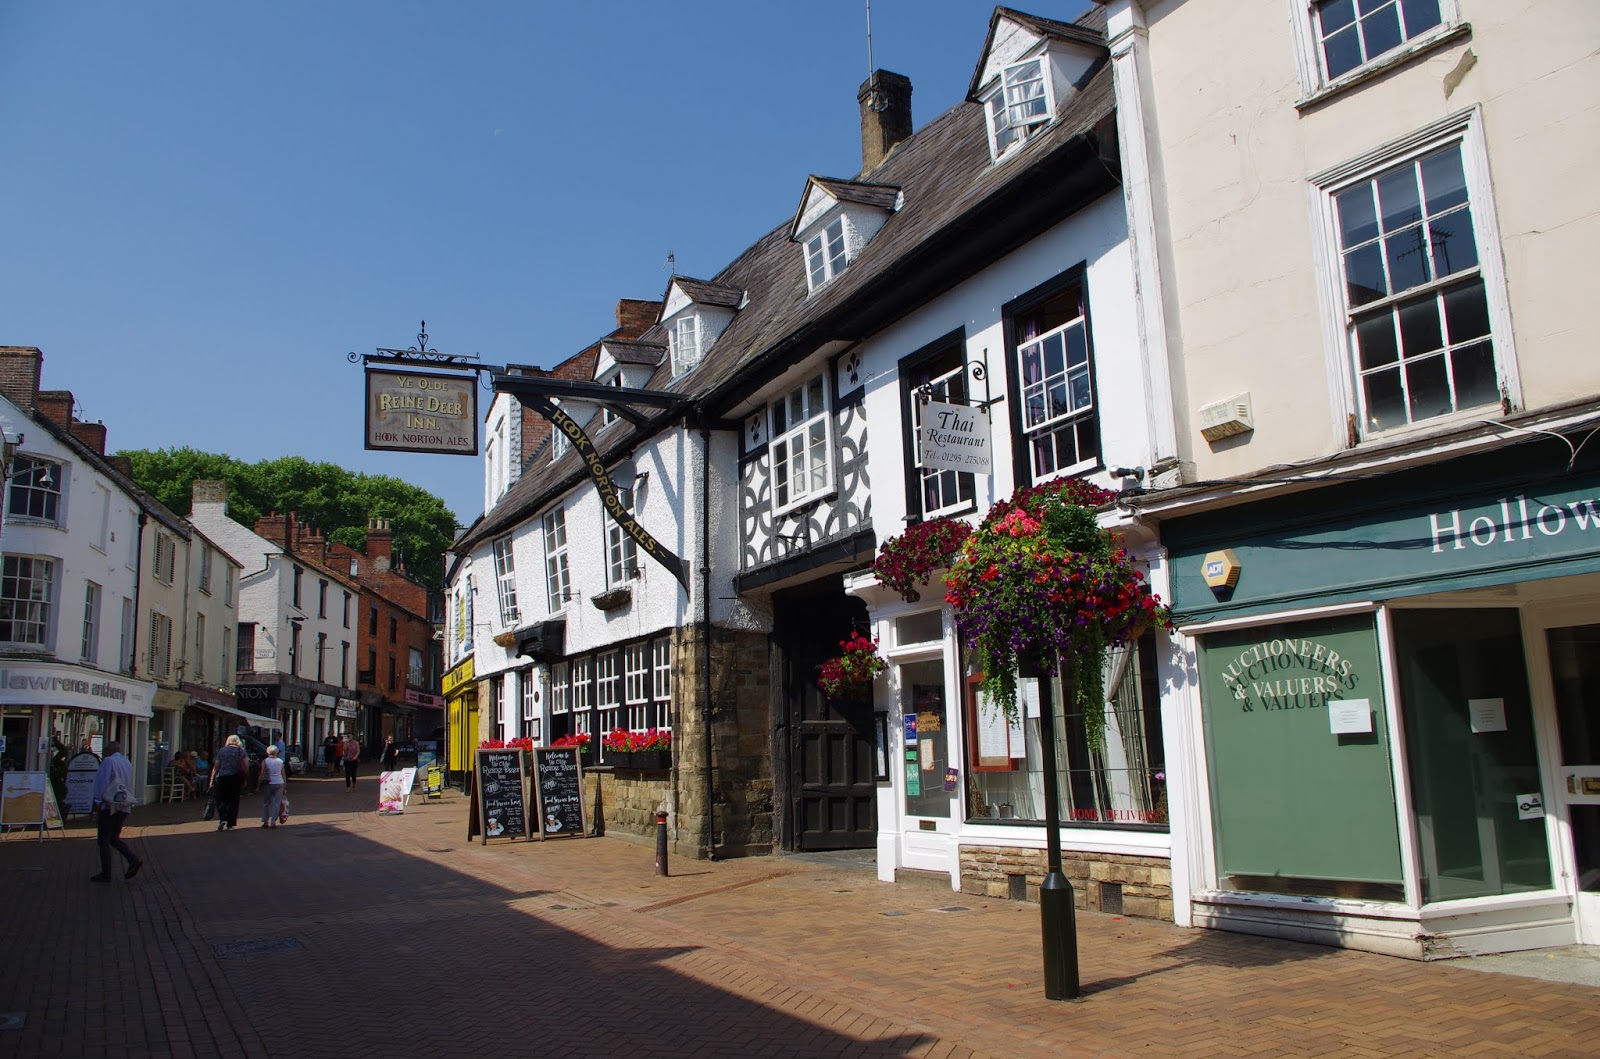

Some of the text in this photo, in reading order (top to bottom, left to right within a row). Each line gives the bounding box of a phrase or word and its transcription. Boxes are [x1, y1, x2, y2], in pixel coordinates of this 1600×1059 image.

[397, 377, 448, 391] YE OLDE
[380, 393, 462, 415] REINE DEER
[938, 410, 974, 433] Thai
[374, 432, 399, 442] HOOK
[402, 433, 443, 445] NORTON
[927, 428, 985, 448] Restaurant
[552, 410, 591, 450] HOOK
[586, 452, 625, 518] NORTON
[941, 452, 962, 463] 01295
[1208, 563, 1222, 574] ADT
[1221, 638, 1352, 687] AUCTIONEERS
[1, 669, 128, 704] lawrence anthony
[1234, 675, 1338, 700] & VALUERS
[1069, 808, 1099, 820] HOME
